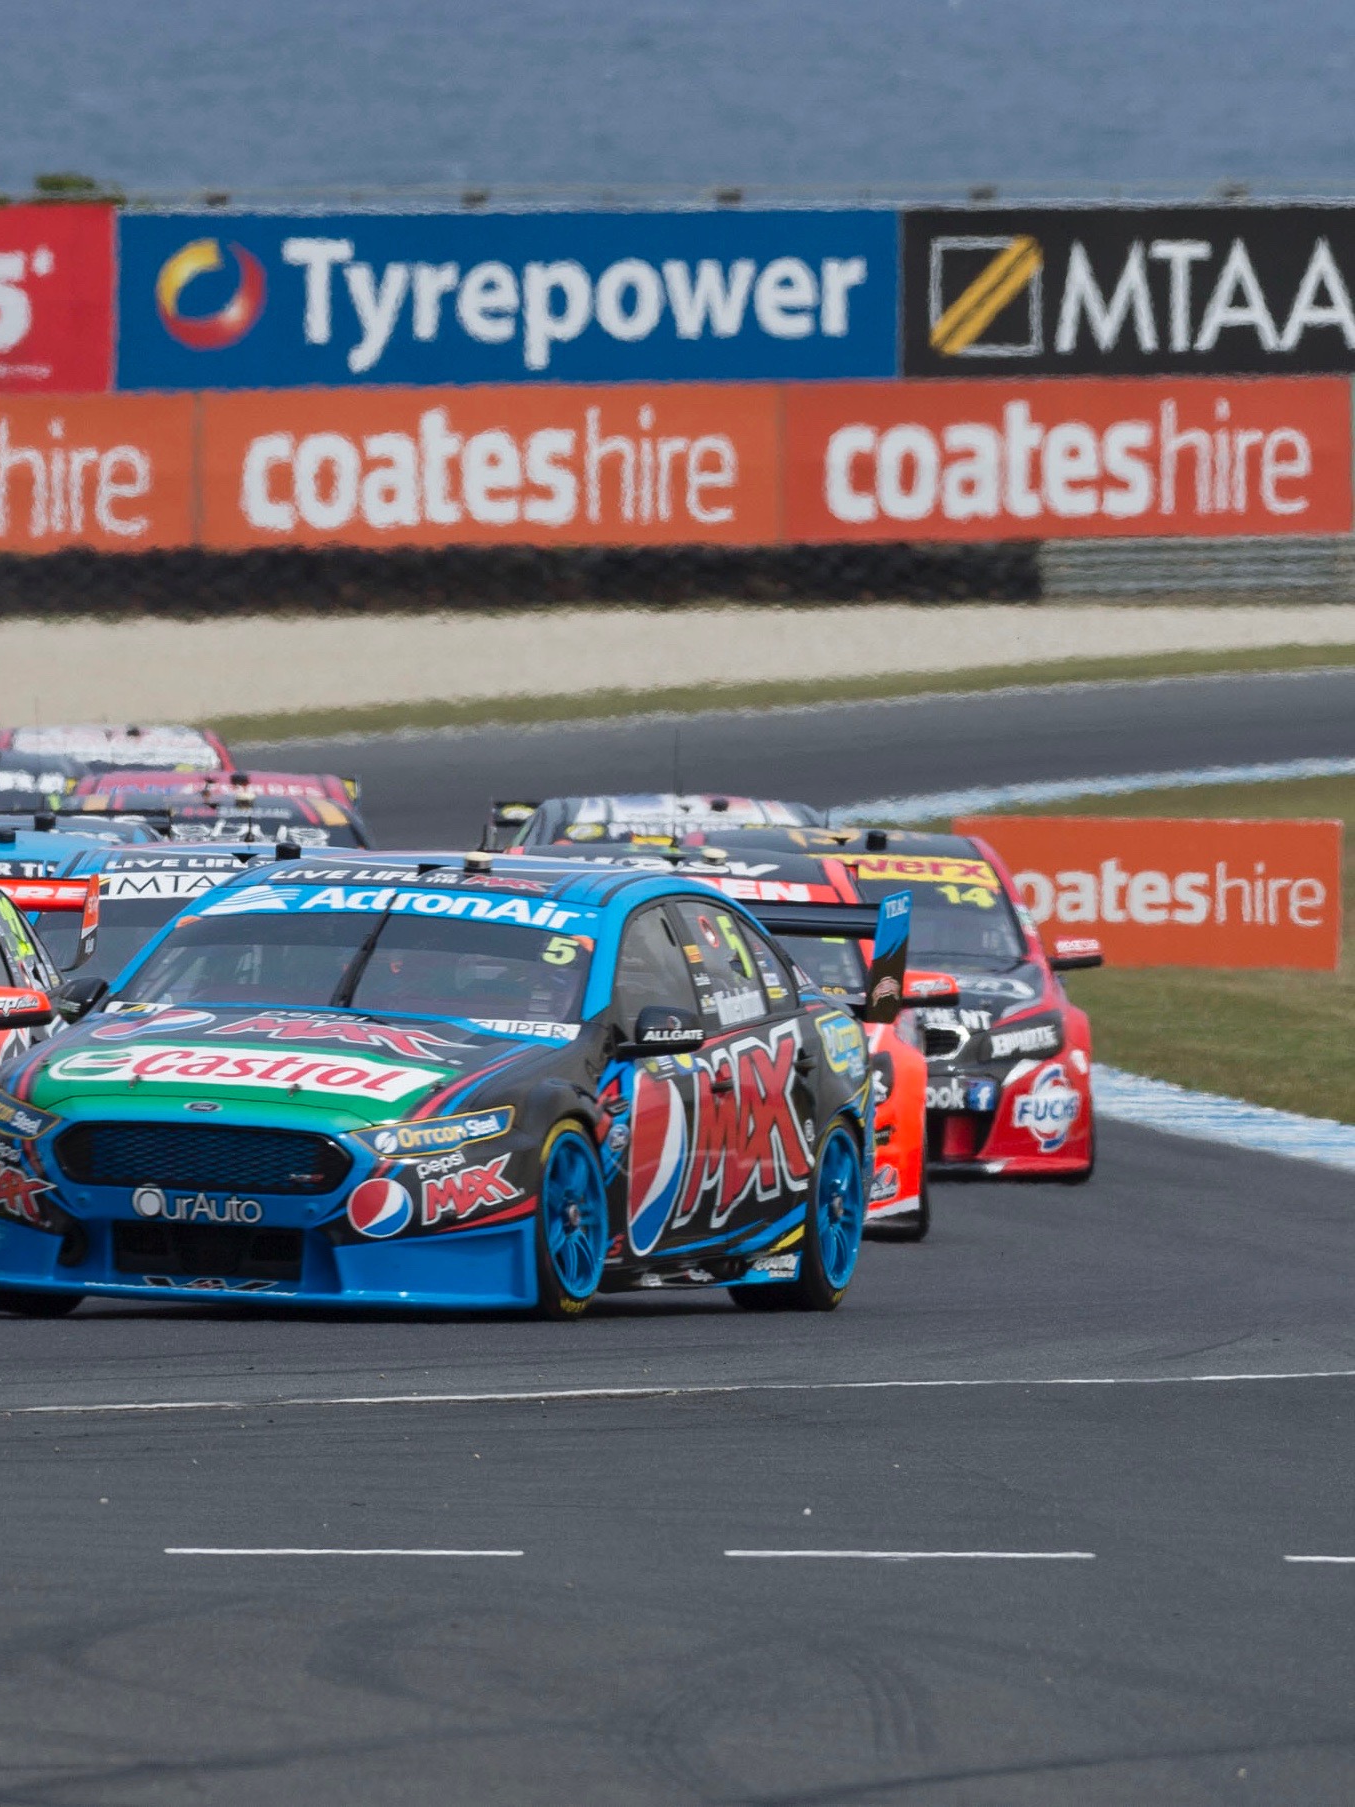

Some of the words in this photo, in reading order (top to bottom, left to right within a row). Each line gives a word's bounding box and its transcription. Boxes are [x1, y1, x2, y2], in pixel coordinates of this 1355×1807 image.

[282, 237, 867, 372] Tyrepower
[1055, 238, 1355, 354] MTAA
[105, 859, 180, 870] LIVE
[268, 869, 355, 881] LIVE
[298, 886, 581, 930] ActronAir
[936, 884, 996, 909] 14
[542, 936, 580, 967] 5
[258, 1010, 371, 1023] pepsi
[643, 1028, 704, 1042] ALLGATE
[132, 1049, 408, 1092] Castrol
[397, 1127, 466, 1148] Orrcon
[466, 1115, 501, 1137] Steel
[671, 1018, 815, 1231] MAX
[416, 1151, 466, 1180] pepsi
[421, 1152, 521, 1226] MAX
